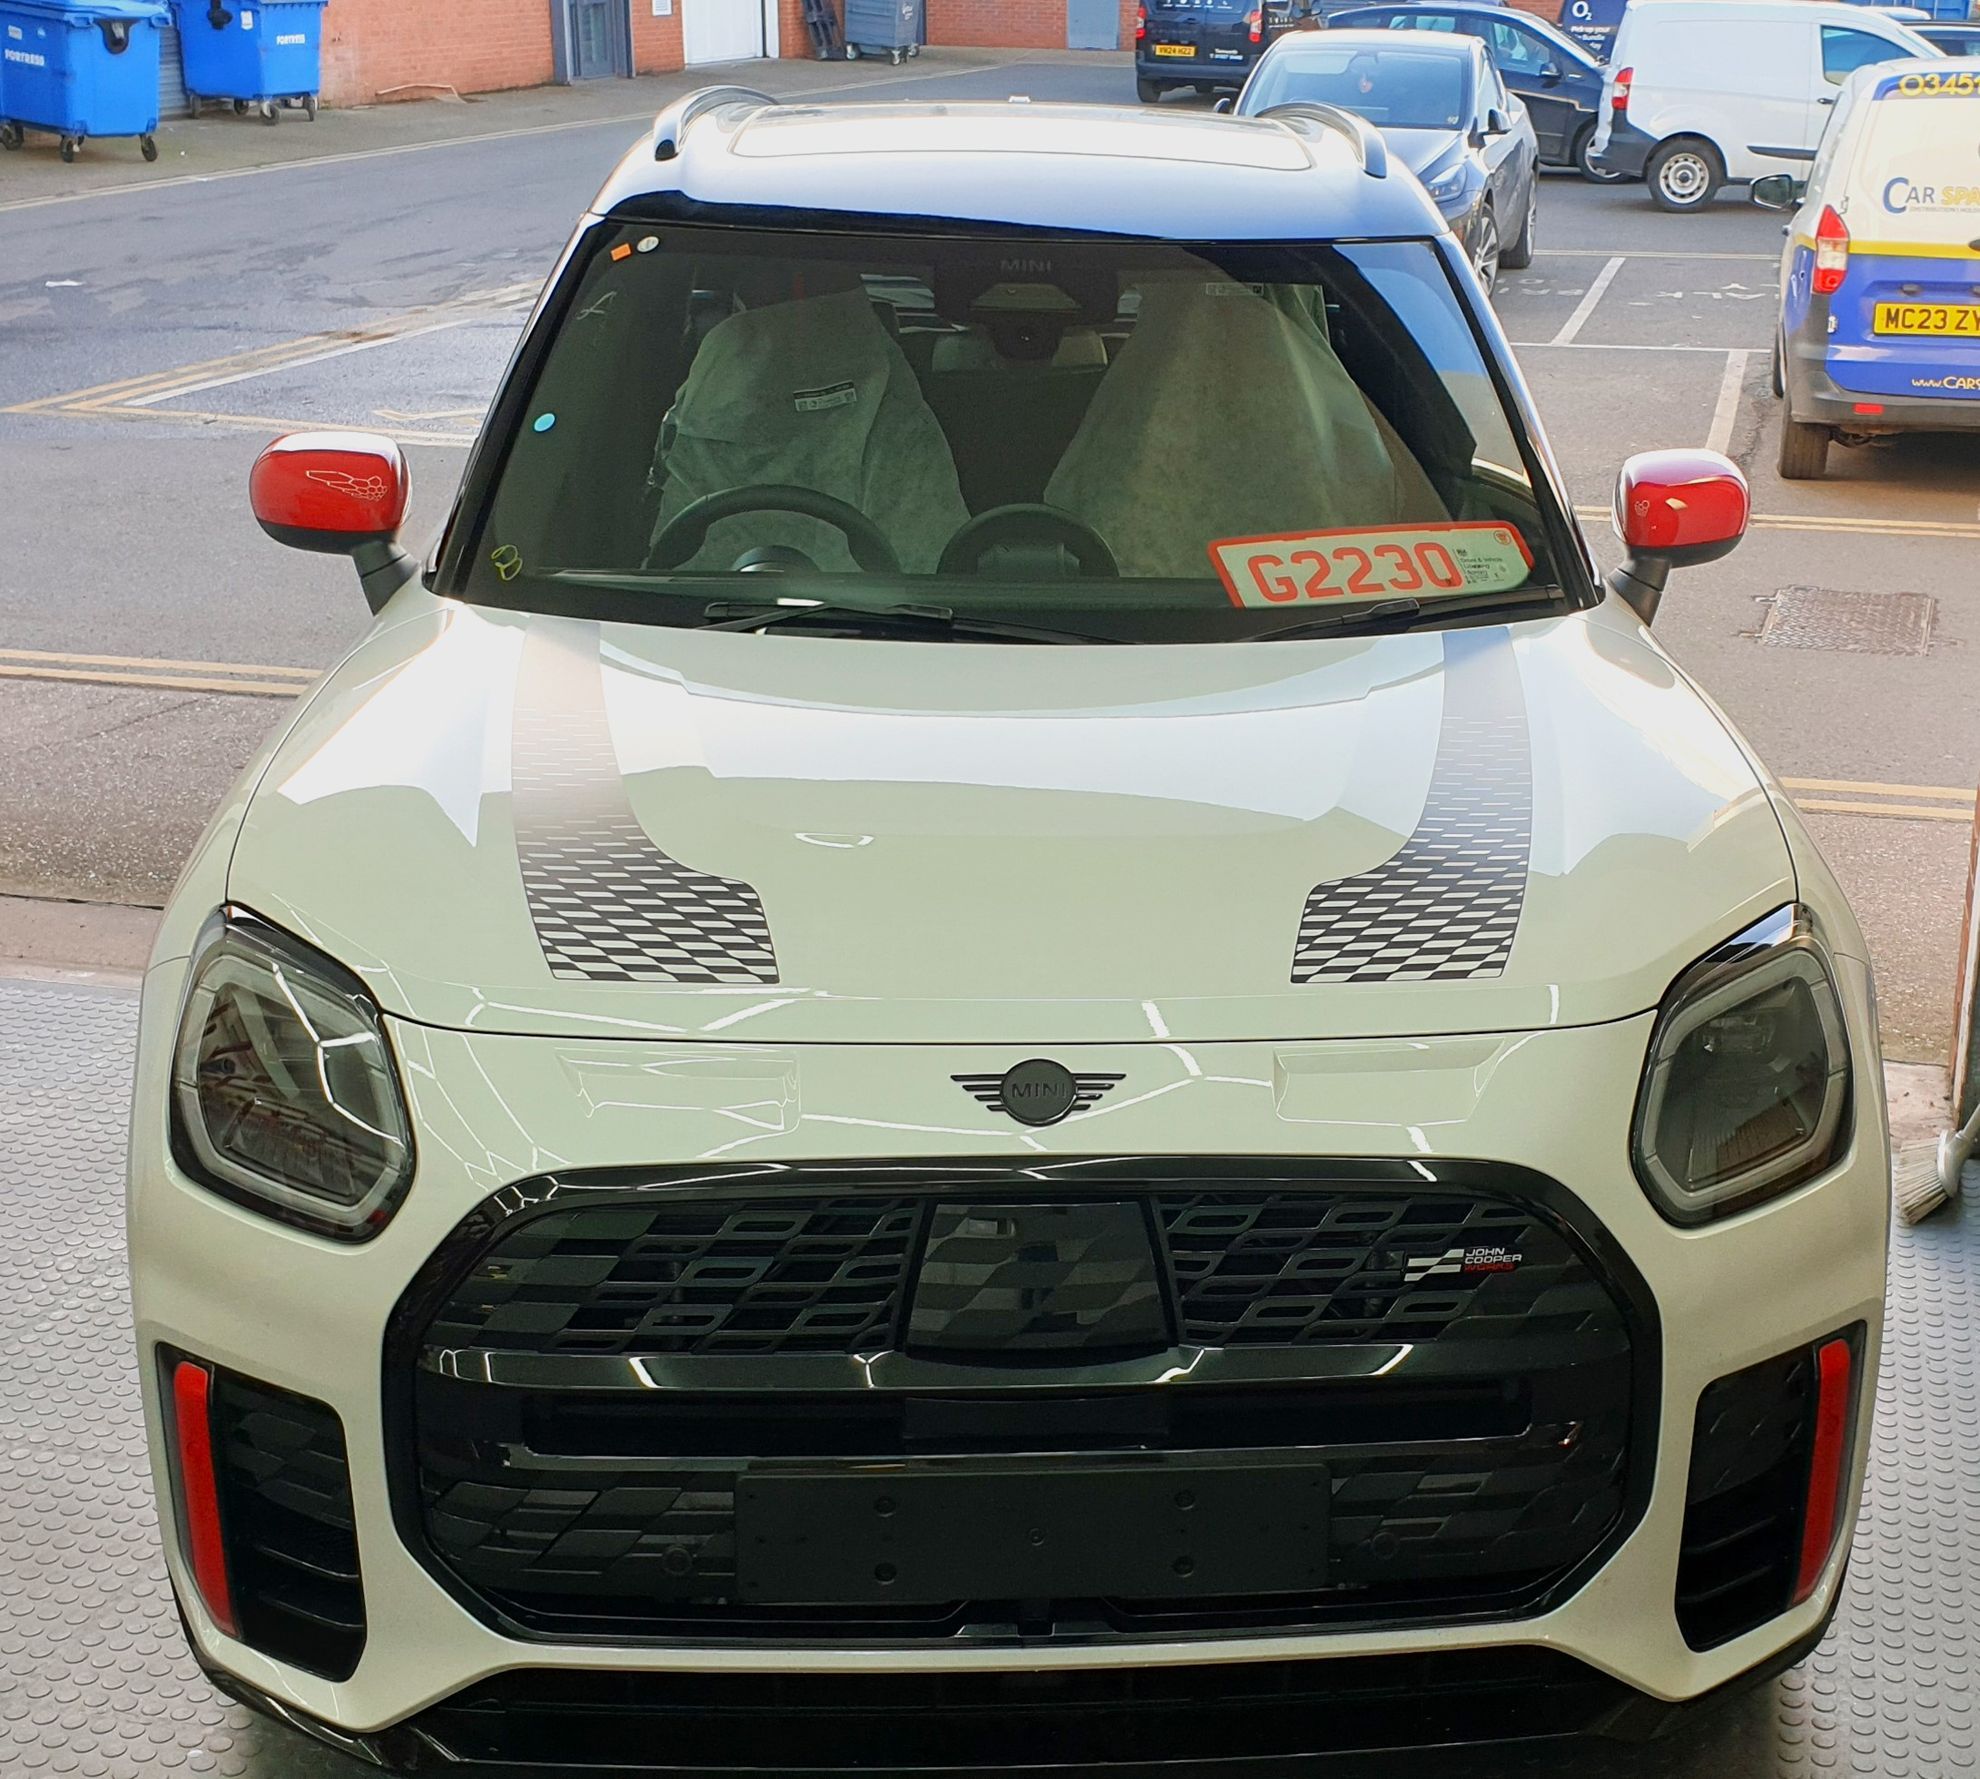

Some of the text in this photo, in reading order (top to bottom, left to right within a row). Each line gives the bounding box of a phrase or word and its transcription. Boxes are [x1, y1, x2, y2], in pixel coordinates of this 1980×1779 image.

[1882, 176, 1935, 214] CAR
[1885, 307, 1948, 330] MC23
[1248, 542, 1464, 603] G2230
[1012, 1083, 1067, 1098] MINI
[1465, 1254, 1522, 1264] COOPER
[1466, 1248, 1505, 1257] JOHN
